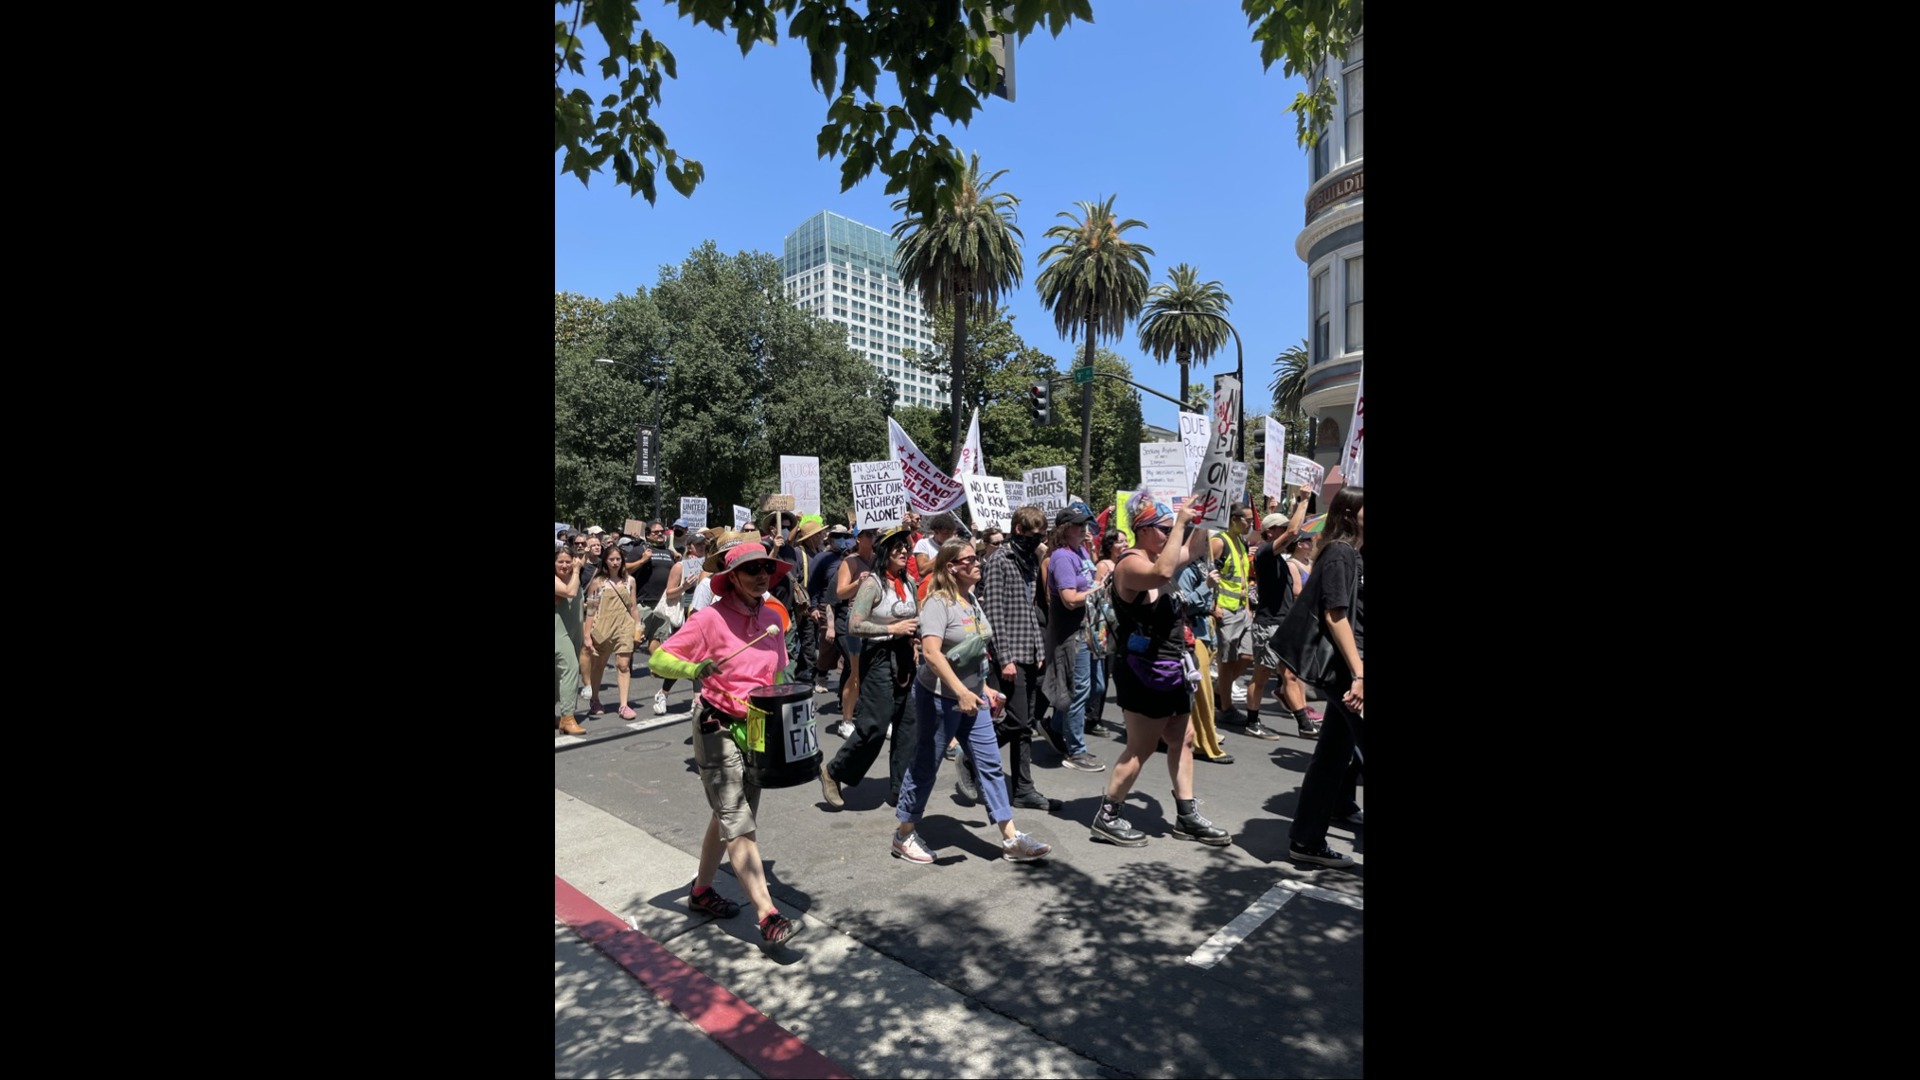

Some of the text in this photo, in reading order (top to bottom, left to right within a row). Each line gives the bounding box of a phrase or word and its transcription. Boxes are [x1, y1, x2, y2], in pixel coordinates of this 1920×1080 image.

[1182, 416, 1205, 435] DUE
[852, 465, 862, 473] IN
[918, 460, 932, 475] EL
[1208, 462, 1230, 485] ON
[901, 458, 956, 499] DEFEND
[1032, 471, 1057, 485] FULL
[855, 482, 904, 498] LEAVE OUR
[970, 482, 1000, 493] NO ICE
[1027, 482, 1064, 498] RIGHTS
[856, 495, 904, 512] NEIGHBORS
[974, 495, 1006, 508] NO KKK
[1047, 499, 1064, 511] ALL
[977, 507, 990, 518] NO
